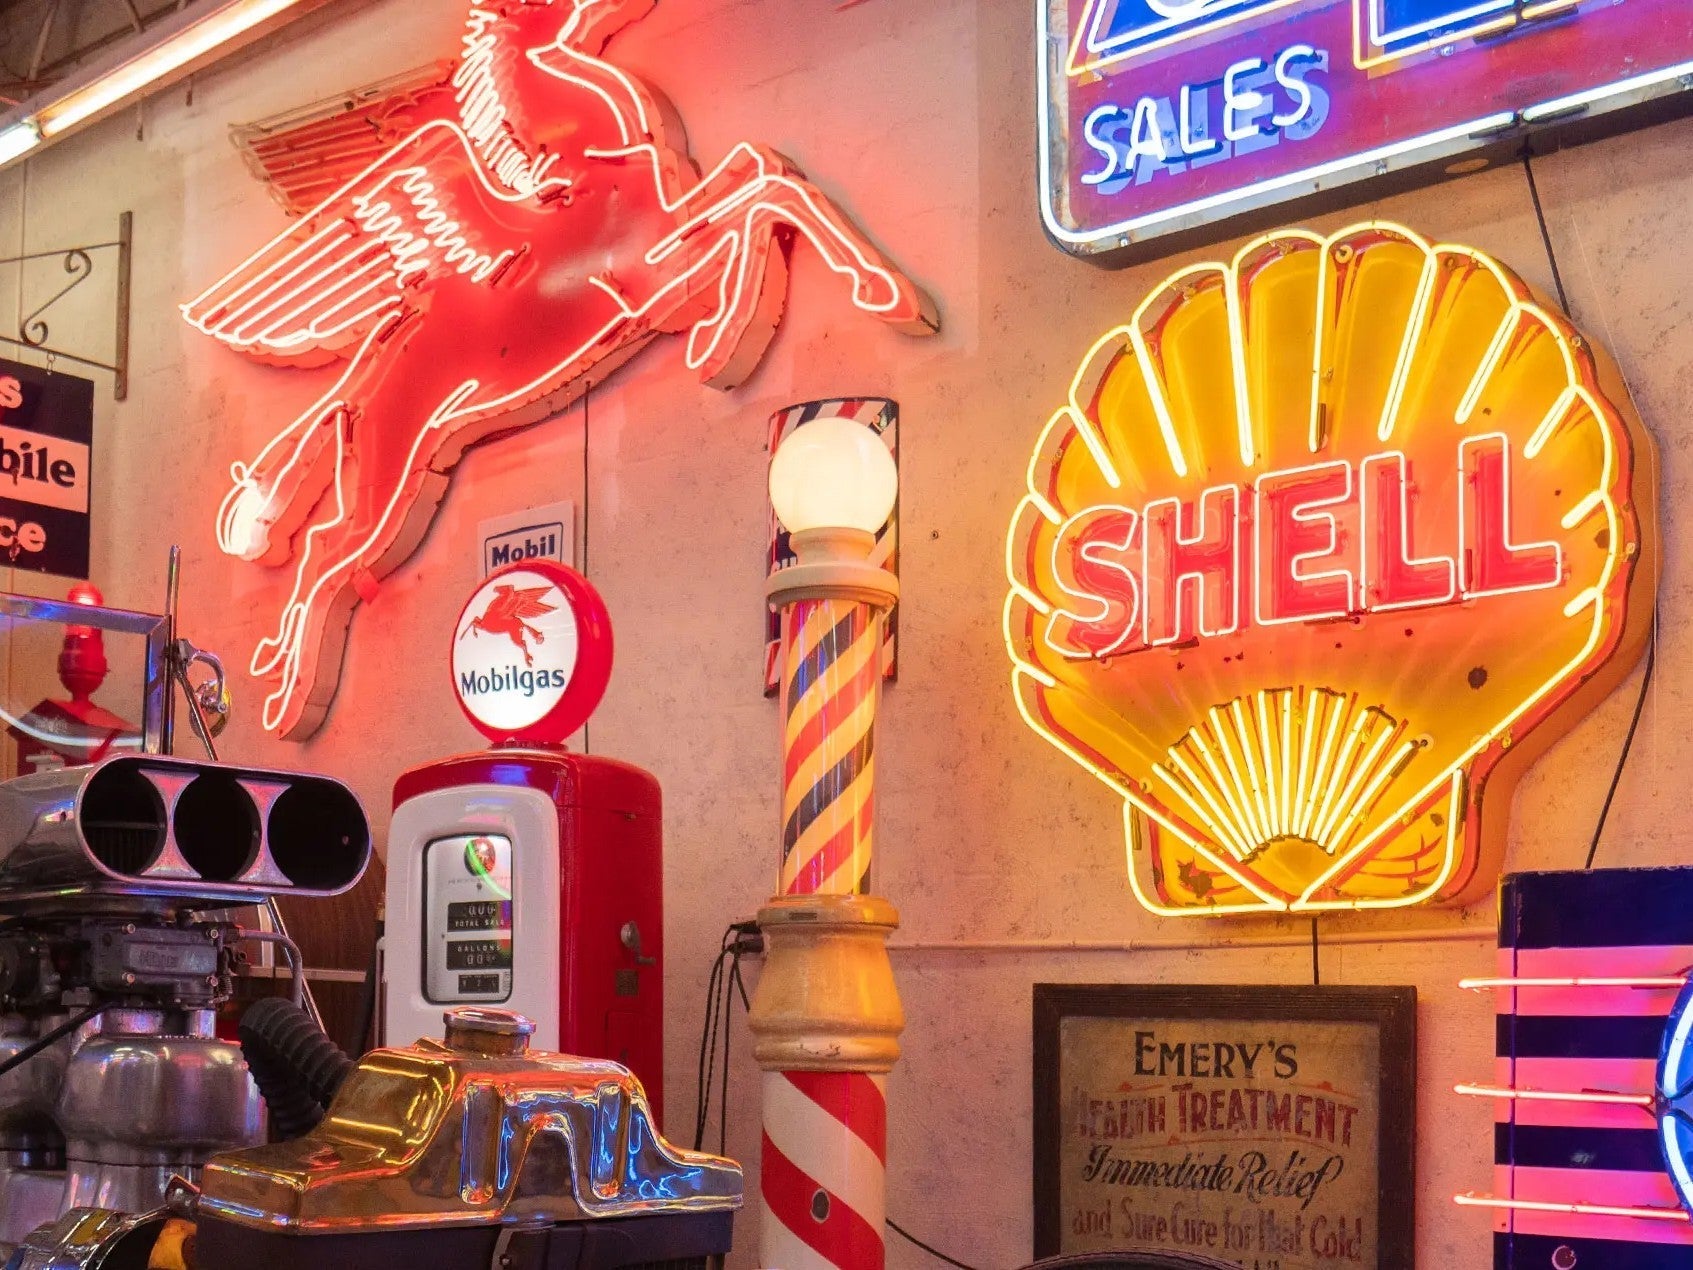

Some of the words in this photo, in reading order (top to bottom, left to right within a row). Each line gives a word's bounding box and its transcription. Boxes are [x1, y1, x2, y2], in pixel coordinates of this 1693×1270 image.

[1082, 44, 1330, 194] SALES
[491, 534, 555, 567] Mobil
[1045, 431, 1563, 659] SHELL
[460, 665, 566, 698] Mobilgas
[455, 920, 479, 928] TOTAL
[485, 919, 504, 927] SALE
[457, 945, 502, 953] GALLONS
[1134, 1031, 1298, 1079] EMERY'S
[1171, 1083, 1359, 1148] TREATMENT
[1081, 1144, 1234, 1191] Immediate
[1233, 1150, 1344, 1210] Relief
[1072, 1199, 1112, 1239] and
[1121, 1196, 1167, 1243] Sure
[1171, 1201, 1218, 1247] Cure
